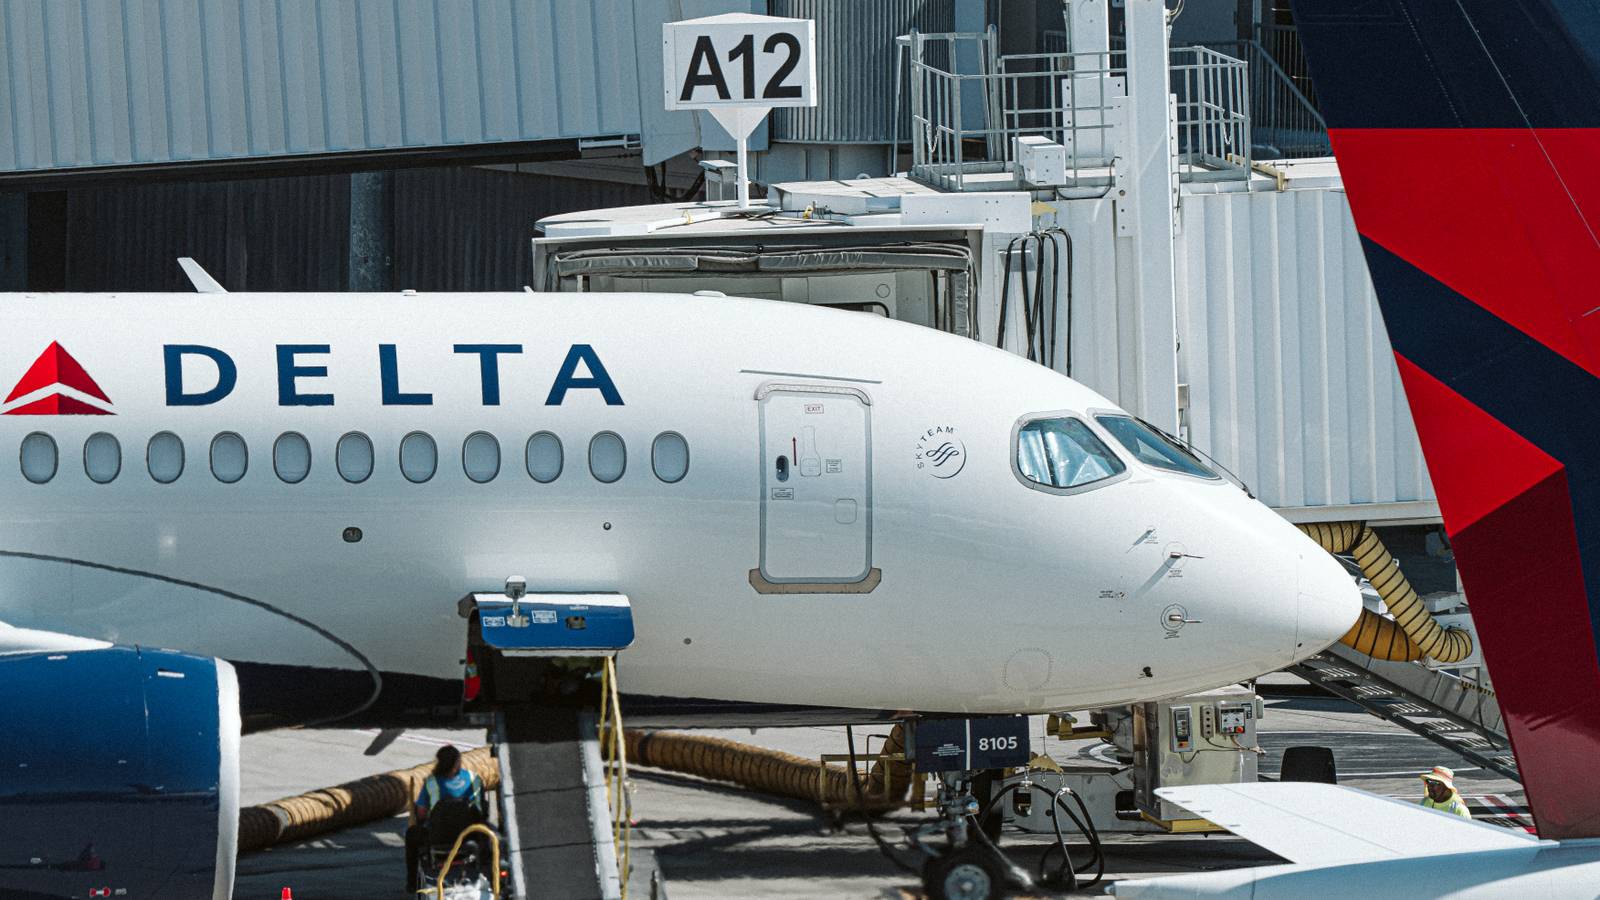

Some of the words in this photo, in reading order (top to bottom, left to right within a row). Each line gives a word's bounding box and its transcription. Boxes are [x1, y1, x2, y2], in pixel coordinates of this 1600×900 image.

[680, 32, 802, 101] A12
[163, 344, 625, 406] DELTA
[915, 426, 954, 469] SKYTEAM
[979, 736, 1018, 751] 8105
